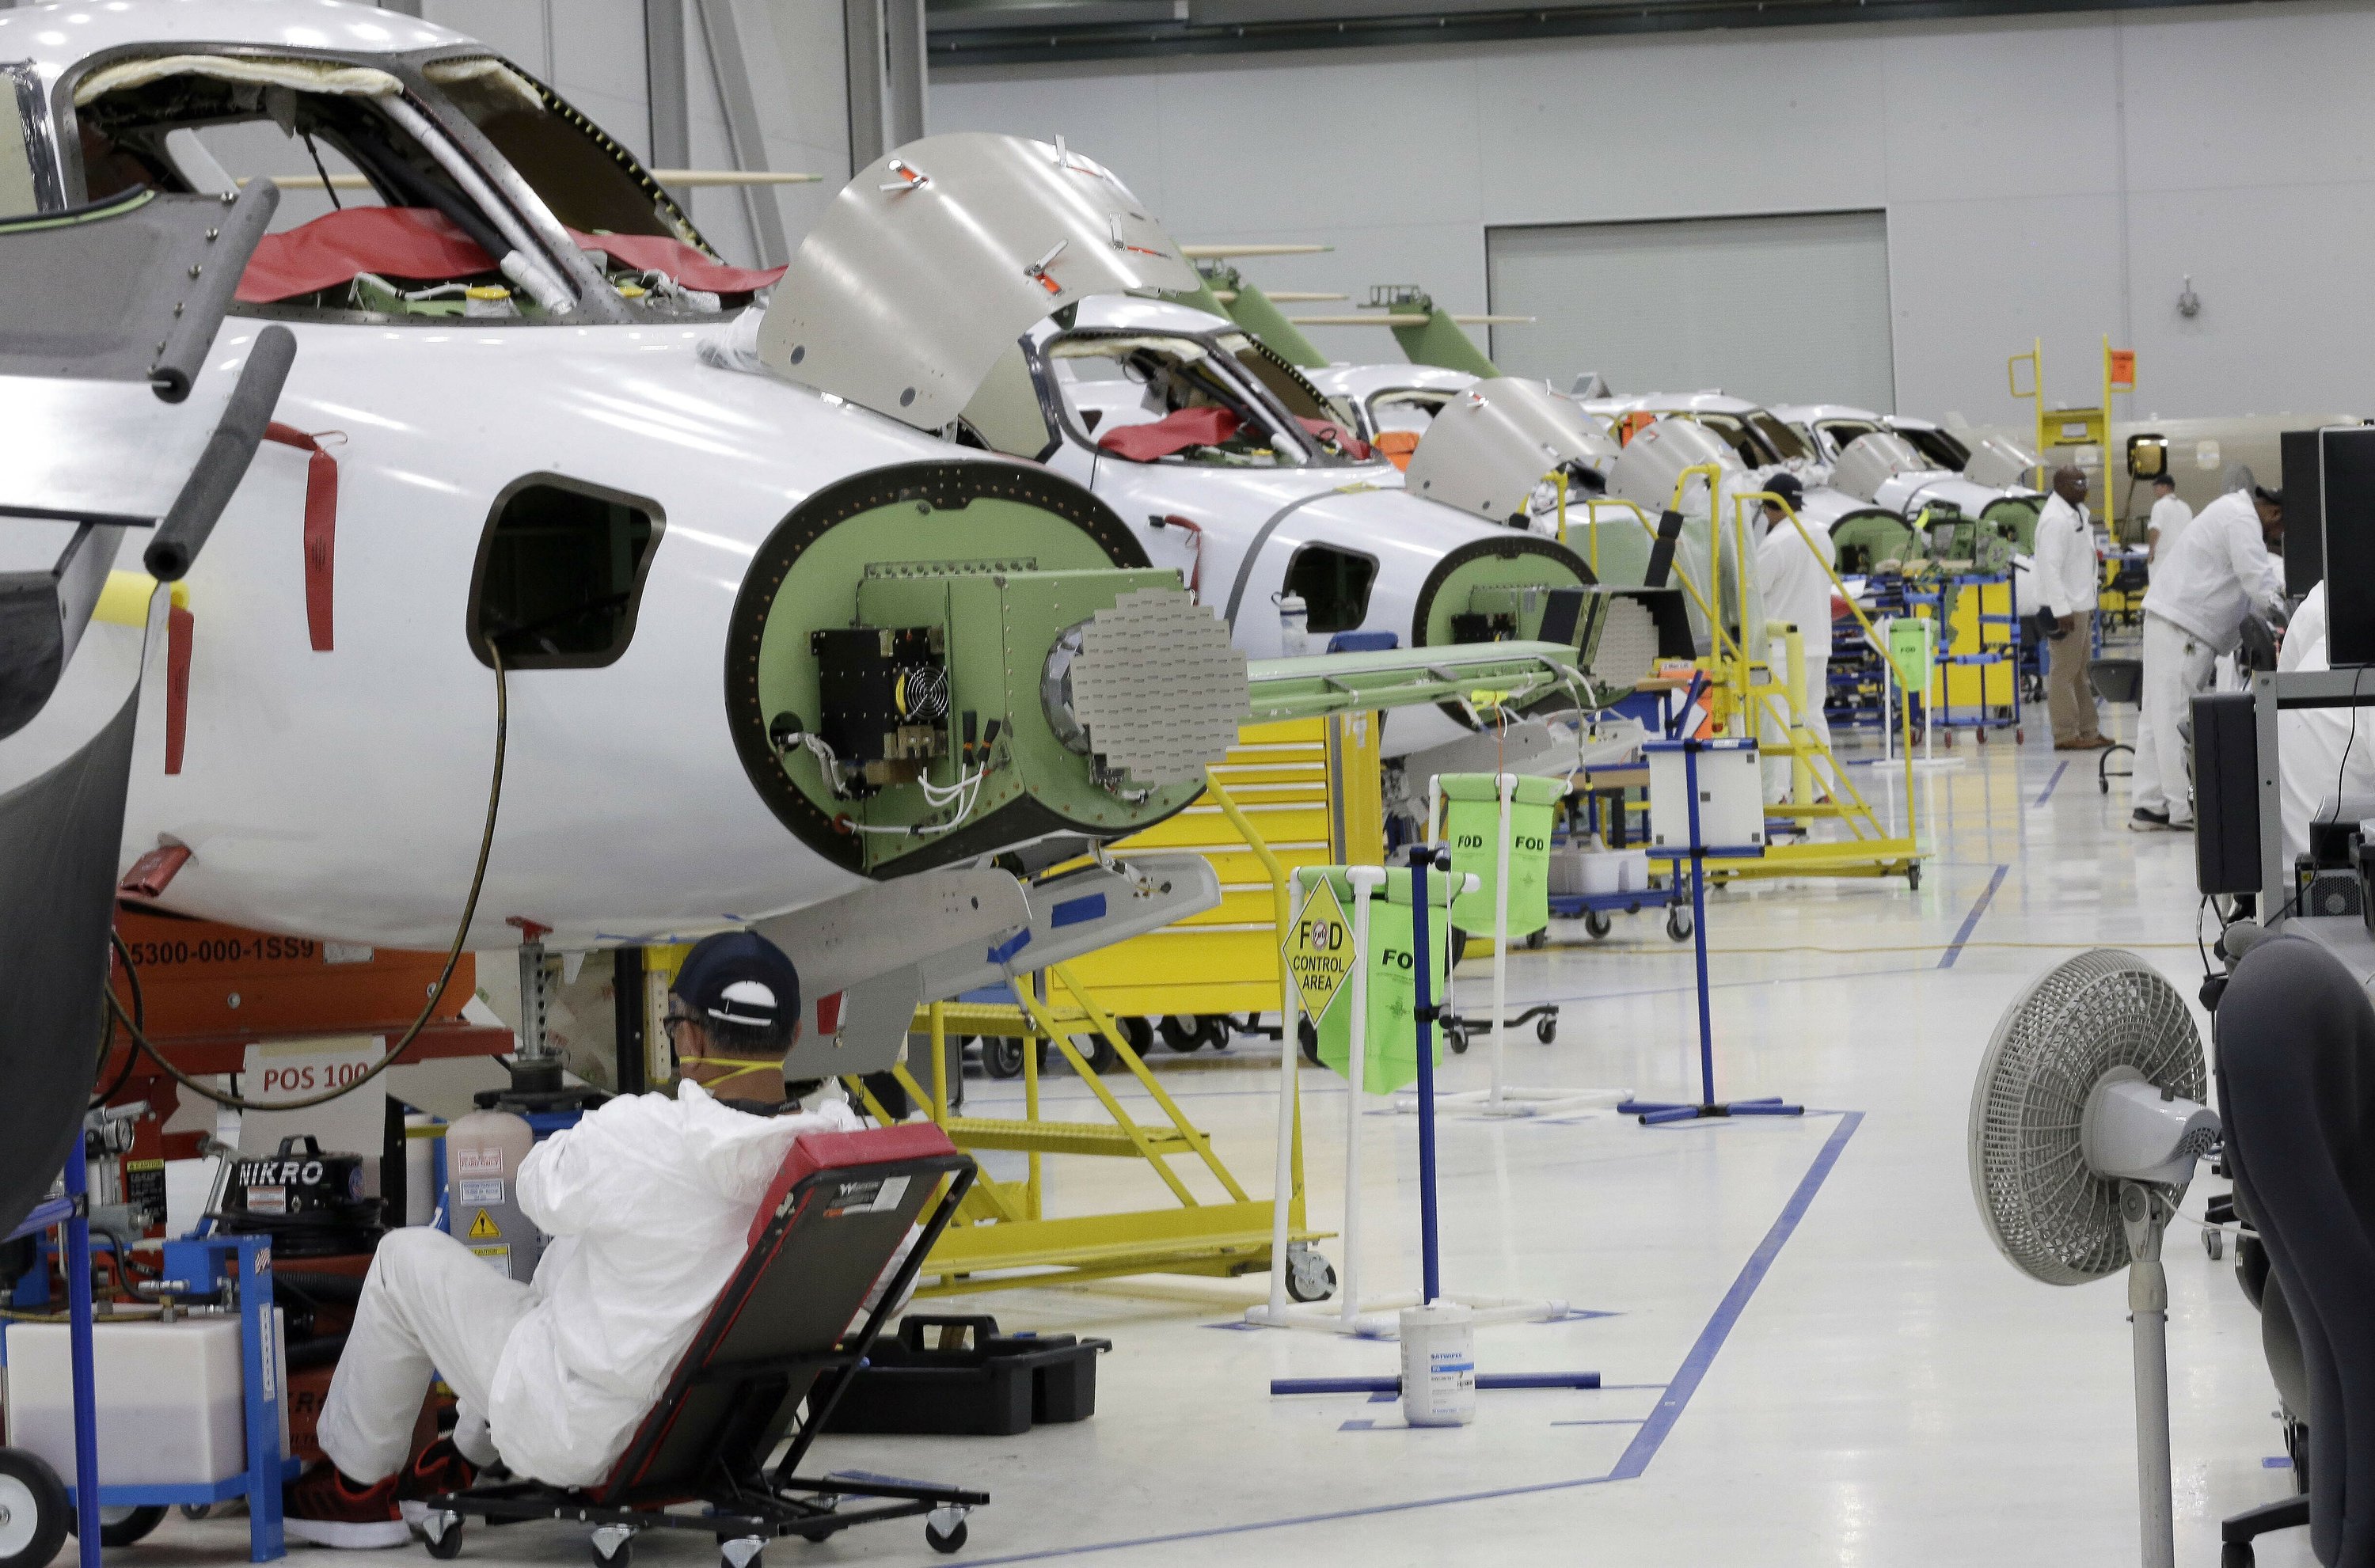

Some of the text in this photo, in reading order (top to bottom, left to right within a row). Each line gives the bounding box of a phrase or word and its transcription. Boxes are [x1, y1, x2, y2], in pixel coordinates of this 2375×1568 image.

[1458, 835, 1483, 849] FOD
[1515, 835, 1544, 851] FOD
[120, 936, 314, 966] 5300-000-1SS9
[1382, 948, 1413, 970] FO
[1293, 955, 1344, 973] CONTROL
[1302, 974, 1332, 990] AREA
[264, 1061, 369, 1092] POS 100
[239, 1160, 324, 1186] NIKRO
